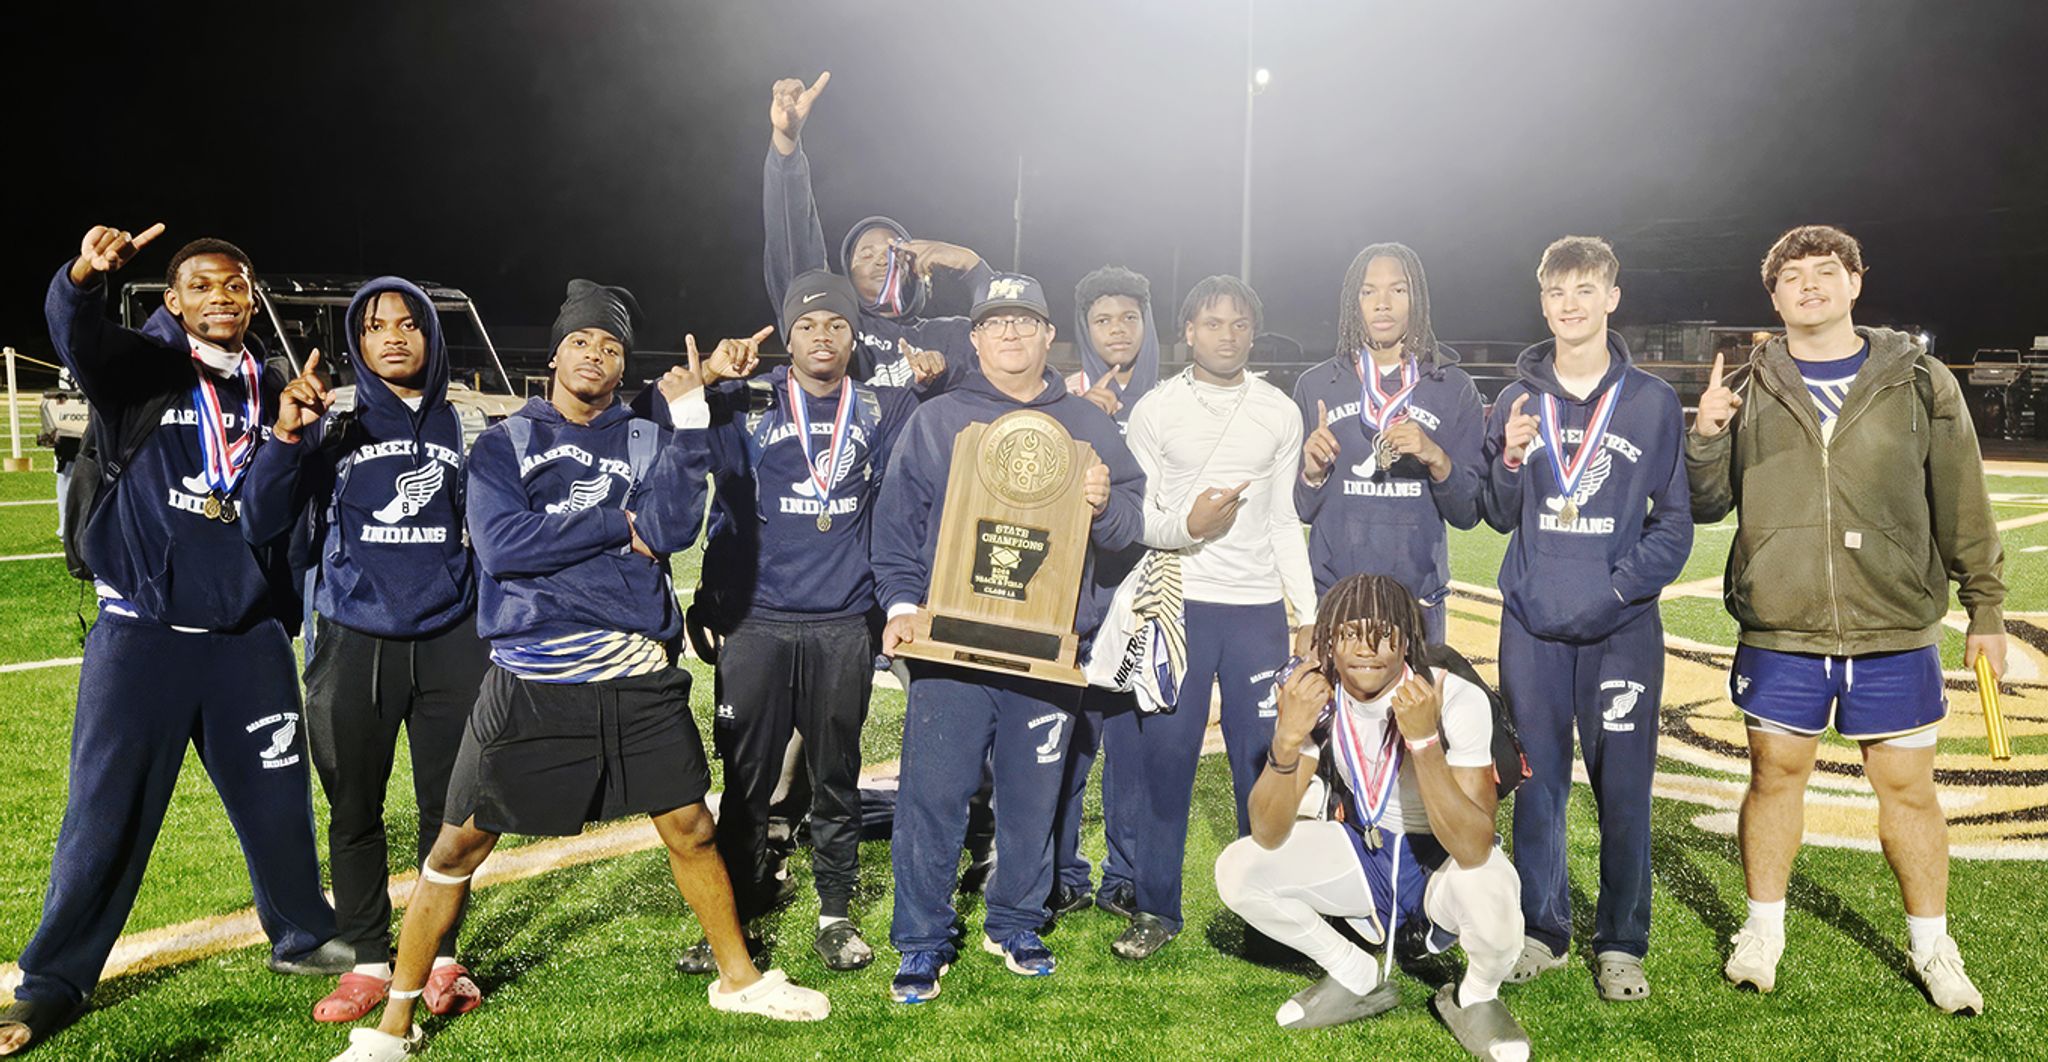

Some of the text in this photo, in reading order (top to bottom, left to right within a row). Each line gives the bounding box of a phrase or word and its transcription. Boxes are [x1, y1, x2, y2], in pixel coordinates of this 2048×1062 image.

[987, 278, 1024, 300] MT
[424, 442, 459, 469] TRE
[520, 444, 632, 484] MARKED TRE
[1343, 480, 1422, 497] INDIANS
[401, 502, 410, 514] 8
[779, 496, 858, 514] INDANS
[360, 524, 447, 543] INDIANS
[995, 524, 1030, 538] STATE
[982, 533, 1045, 551] CHAMPIONS
[1113, 654, 1134, 688] NIKE
